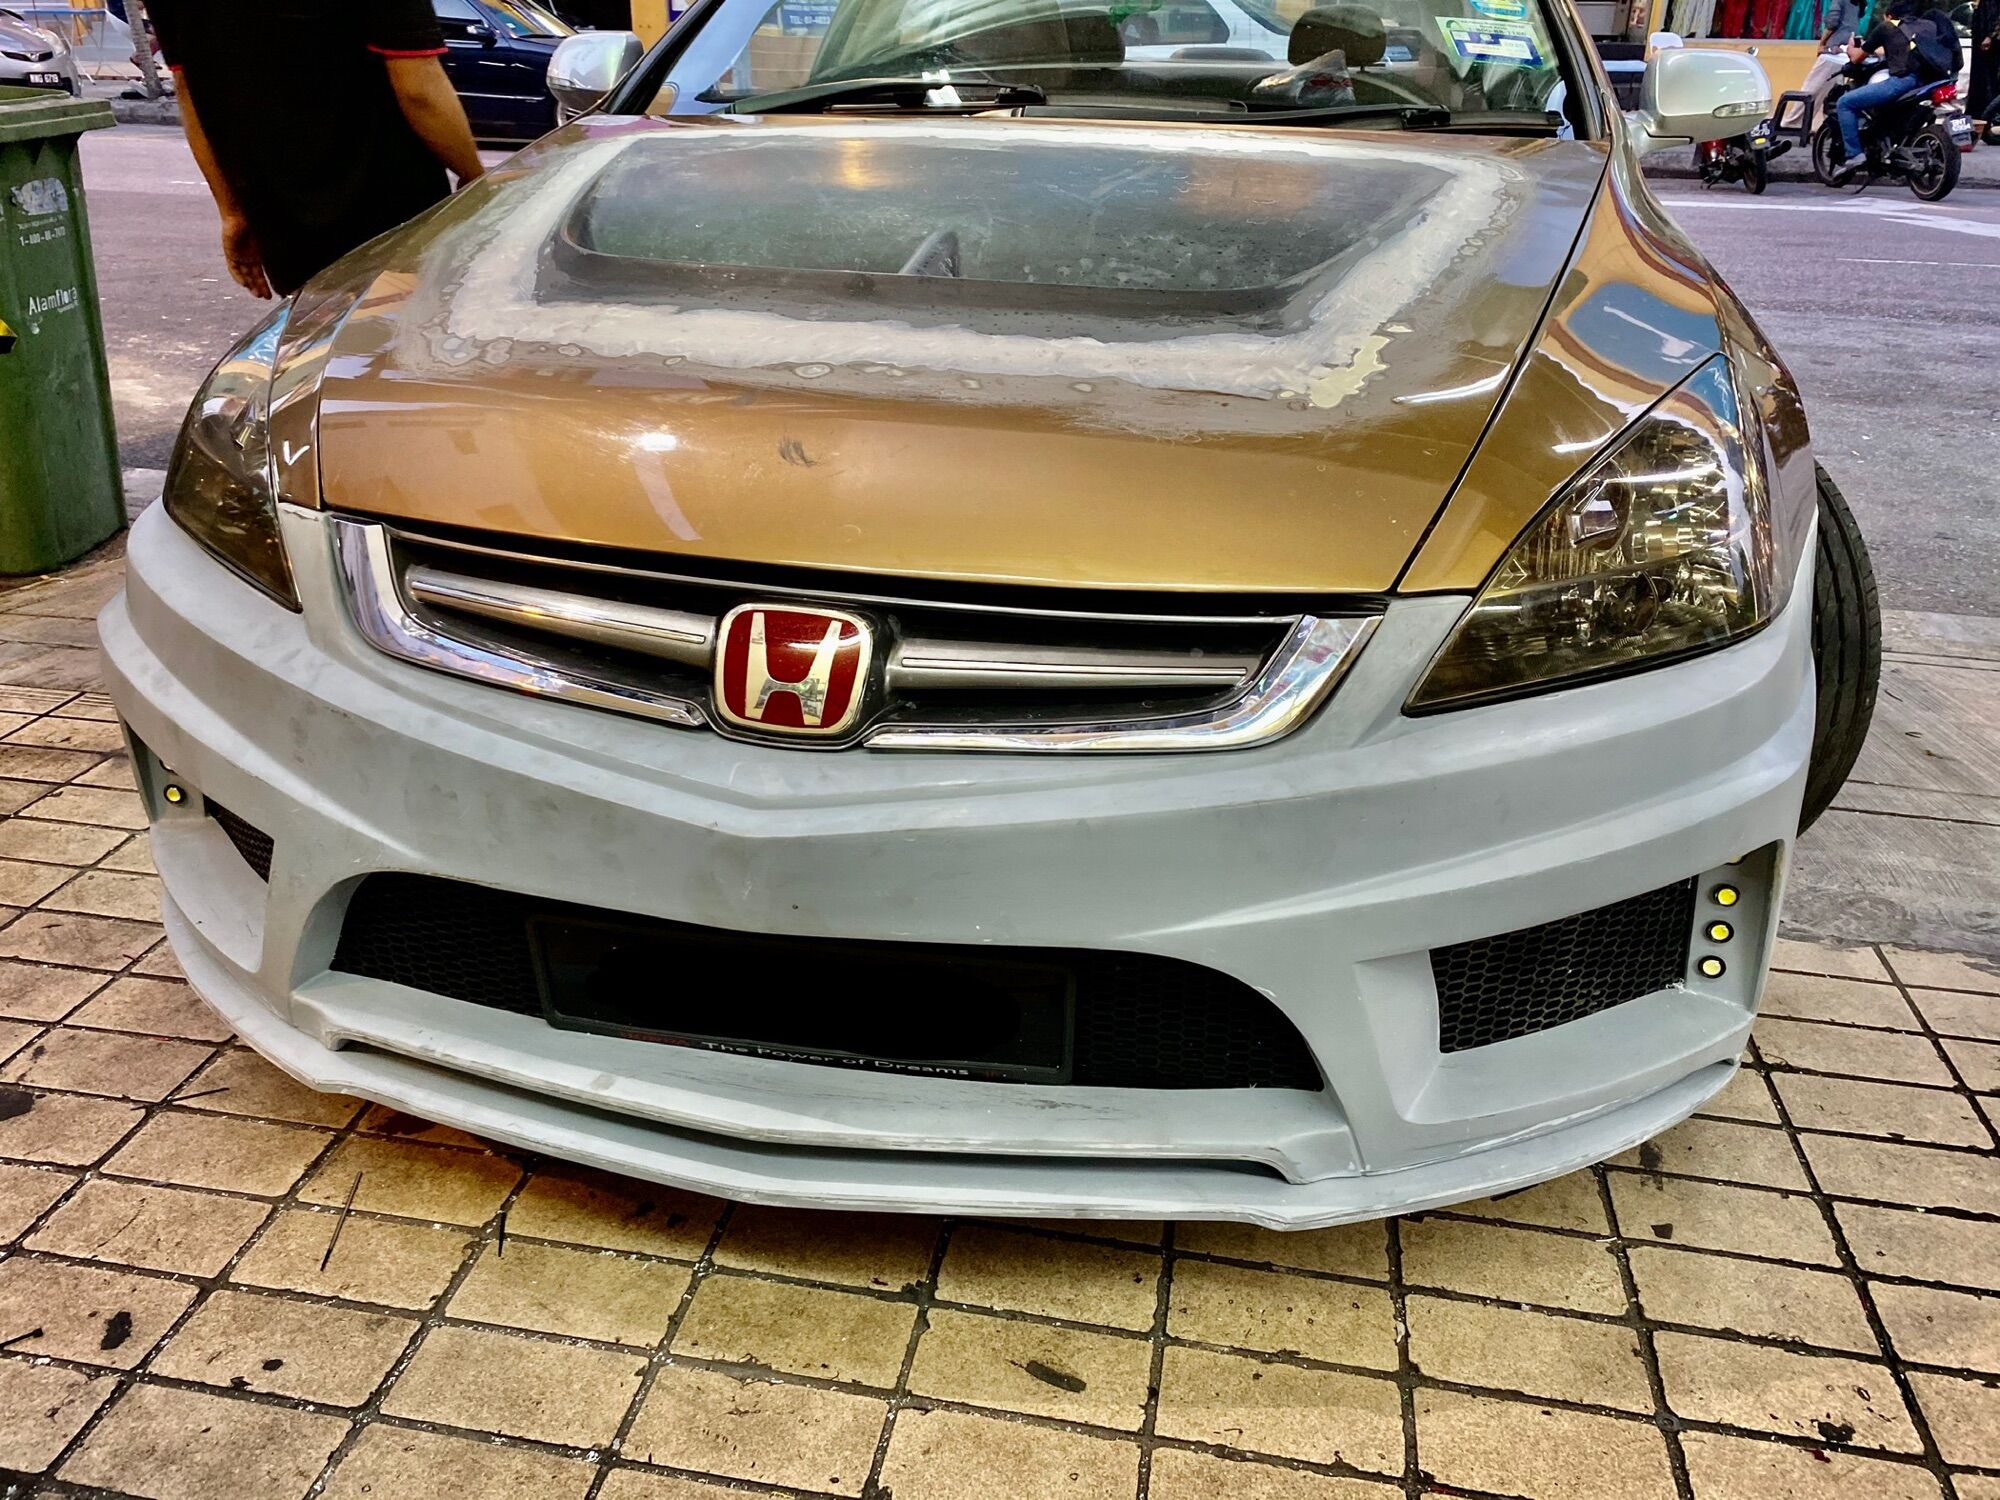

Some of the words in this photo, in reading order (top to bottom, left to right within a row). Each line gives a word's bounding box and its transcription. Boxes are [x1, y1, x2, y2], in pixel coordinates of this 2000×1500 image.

[28, 286, 77, 316] Alamflora
[702, 1041, 749, 1053] The
[757, 1045, 834, 1062] Power
[842, 1058, 866, 1066] of
[874, 1060, 969, 1076] Dreams
